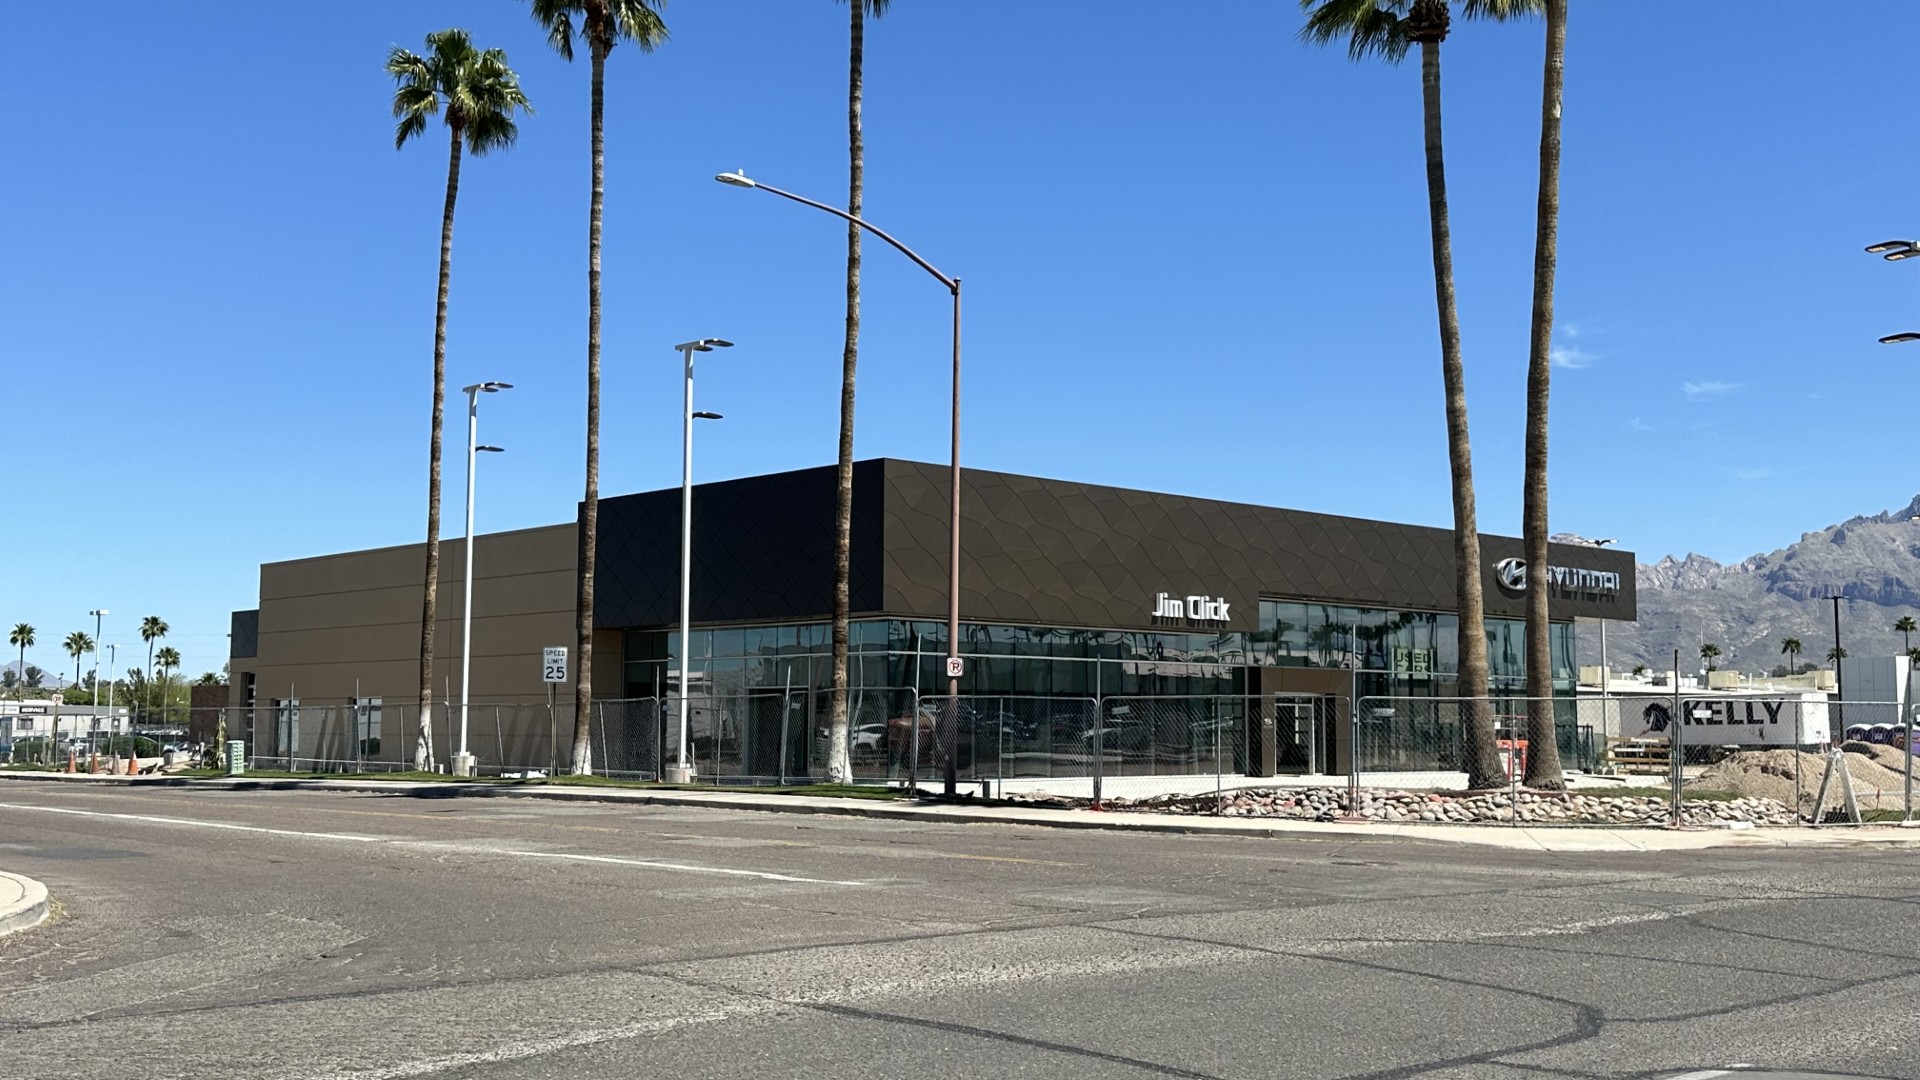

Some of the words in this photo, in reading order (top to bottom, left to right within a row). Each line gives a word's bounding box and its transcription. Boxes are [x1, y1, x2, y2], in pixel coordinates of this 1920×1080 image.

[1152, 592, 1184, 618] Jim
[1187, 595, 1231, 621] Click
[1394, 652, 1431, 663] USED
[545, 666, 565, 679] 25
[1683, 697, 1785, 726] KELLY
